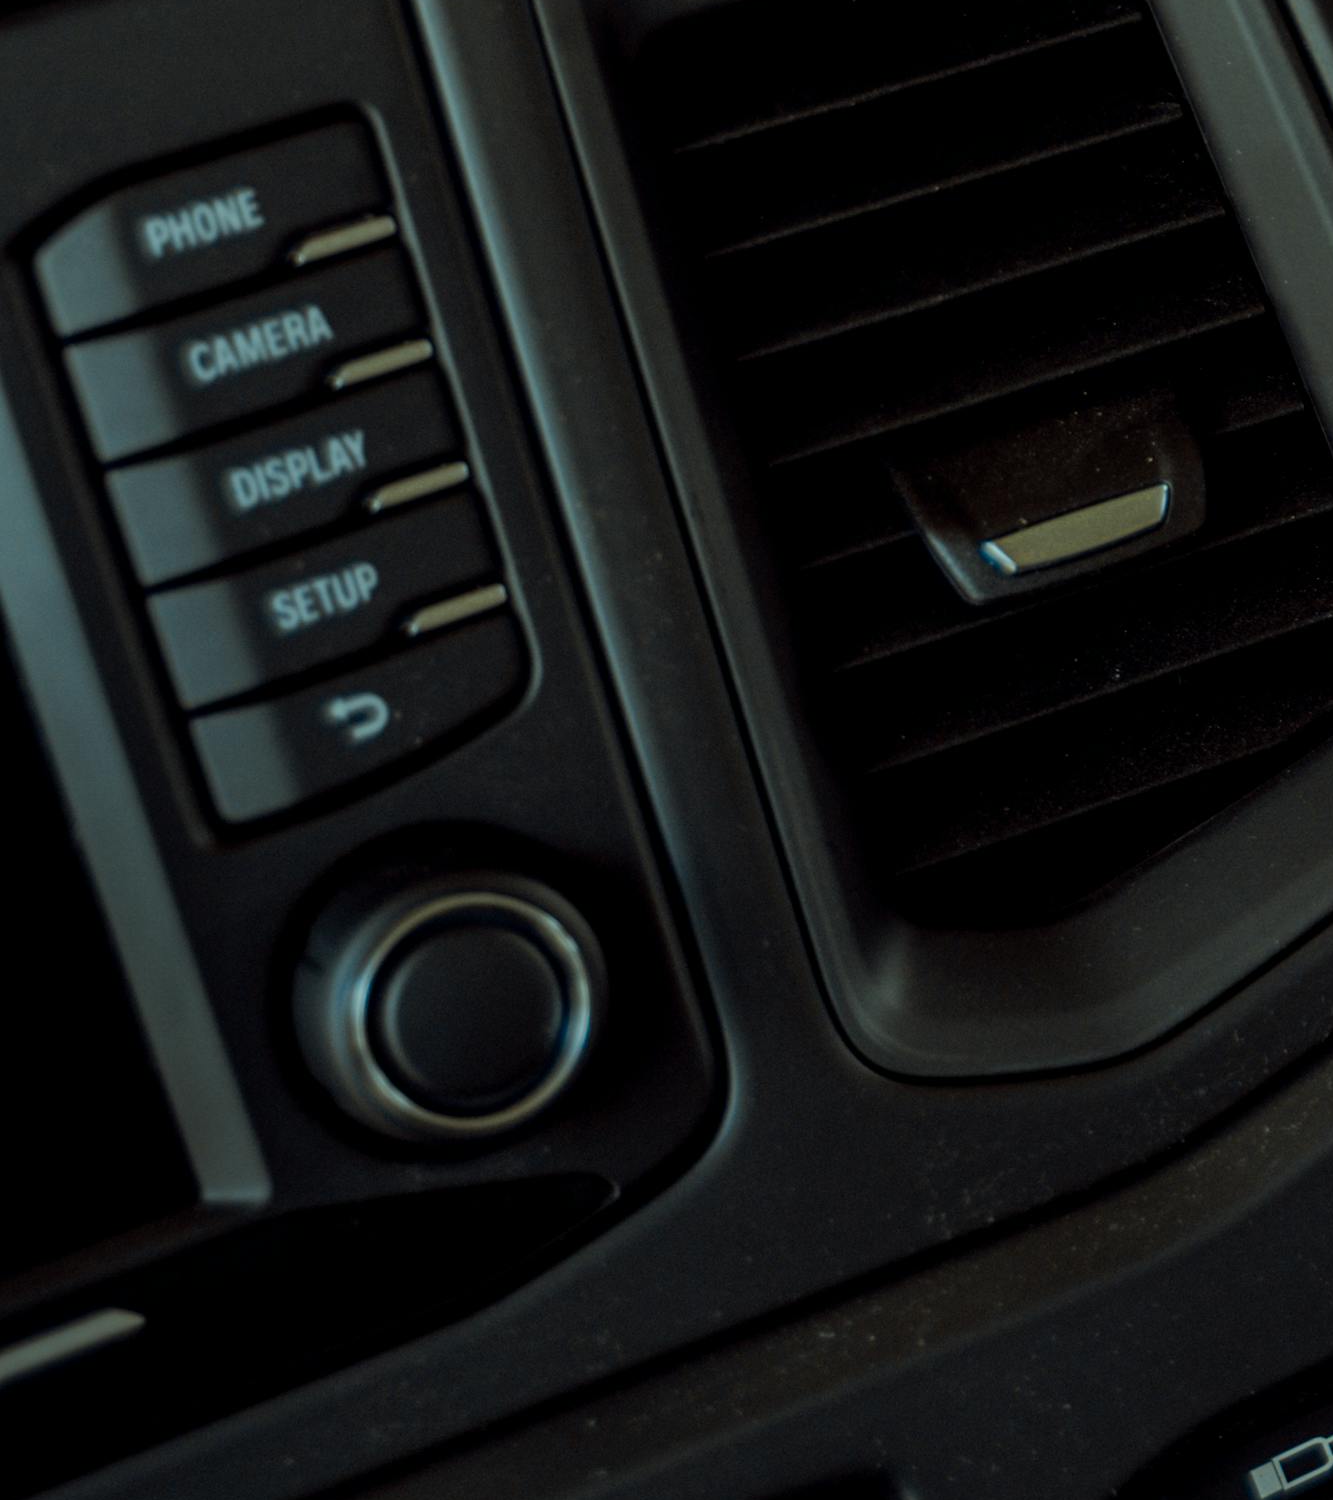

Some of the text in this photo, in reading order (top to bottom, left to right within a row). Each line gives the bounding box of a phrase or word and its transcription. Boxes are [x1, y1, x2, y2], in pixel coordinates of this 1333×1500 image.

[143, 188, 266, 258] PHONE
[187, 304, 334, 385] CAMERA
[230, 429, 368, 513] DISPLAY
[272, 562, 380, 633] SETUP
